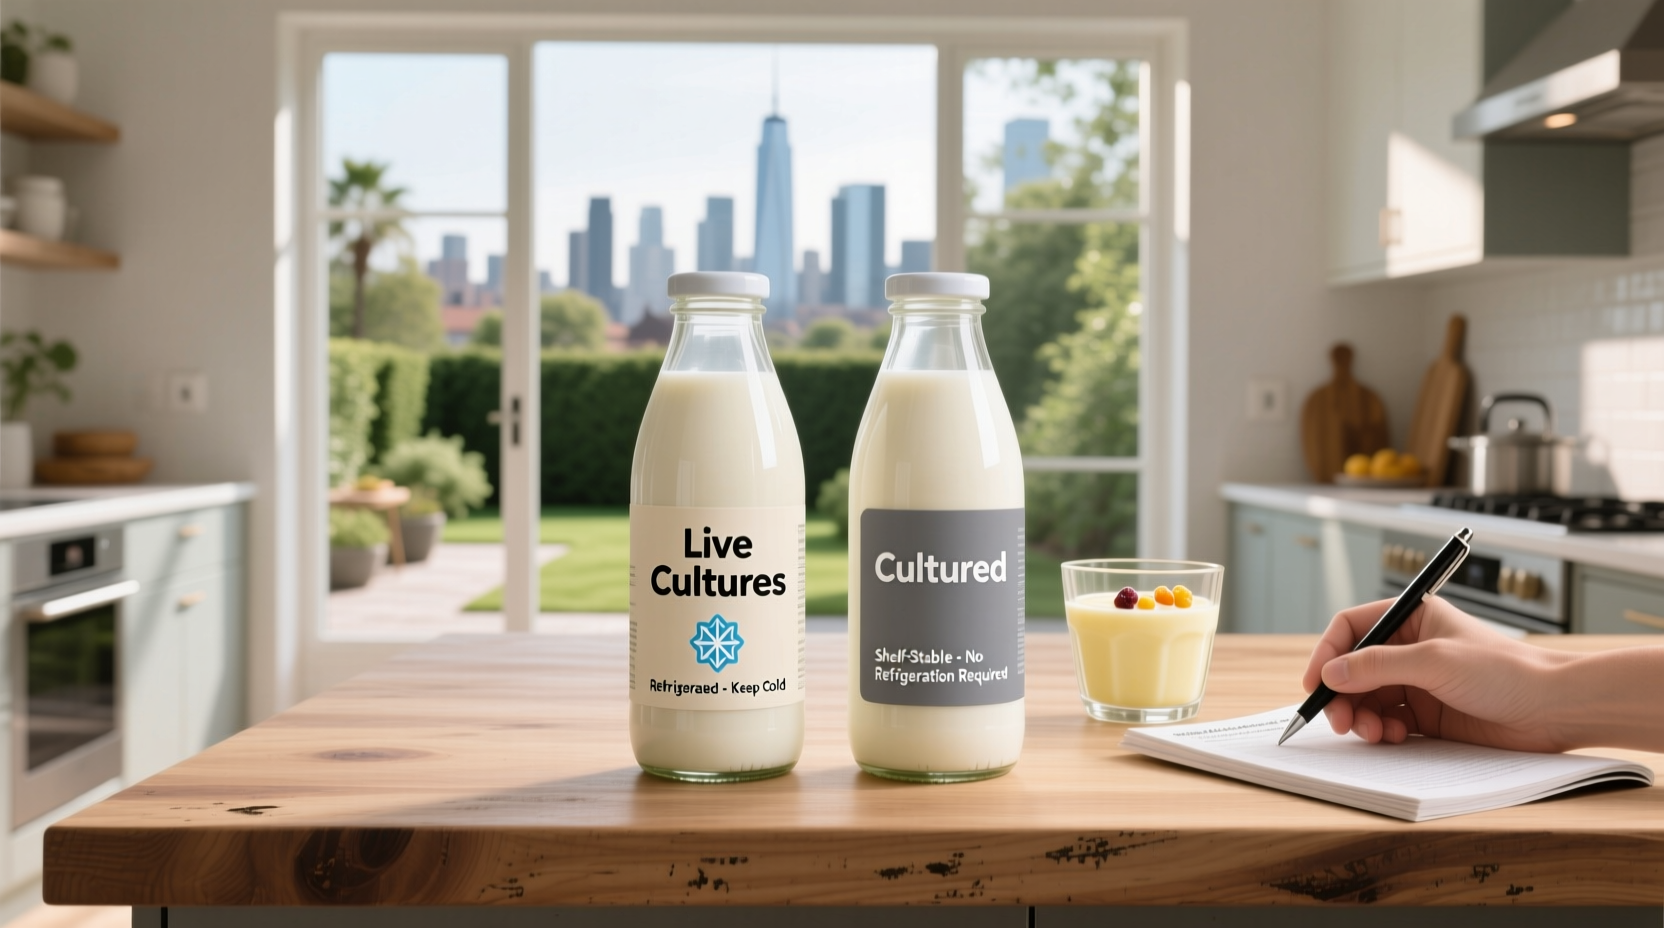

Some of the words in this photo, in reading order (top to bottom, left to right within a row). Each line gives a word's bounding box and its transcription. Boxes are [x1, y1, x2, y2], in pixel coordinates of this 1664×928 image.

[684, 526, 753, 559] Live
[650, 564, 787, 597] Cultures
[874, 550, 1007, 584] Cultured
[965, 649, 984, 664] No
[731, 681, 760, 697] Keep
[762, 677, 786, 692] Cold
